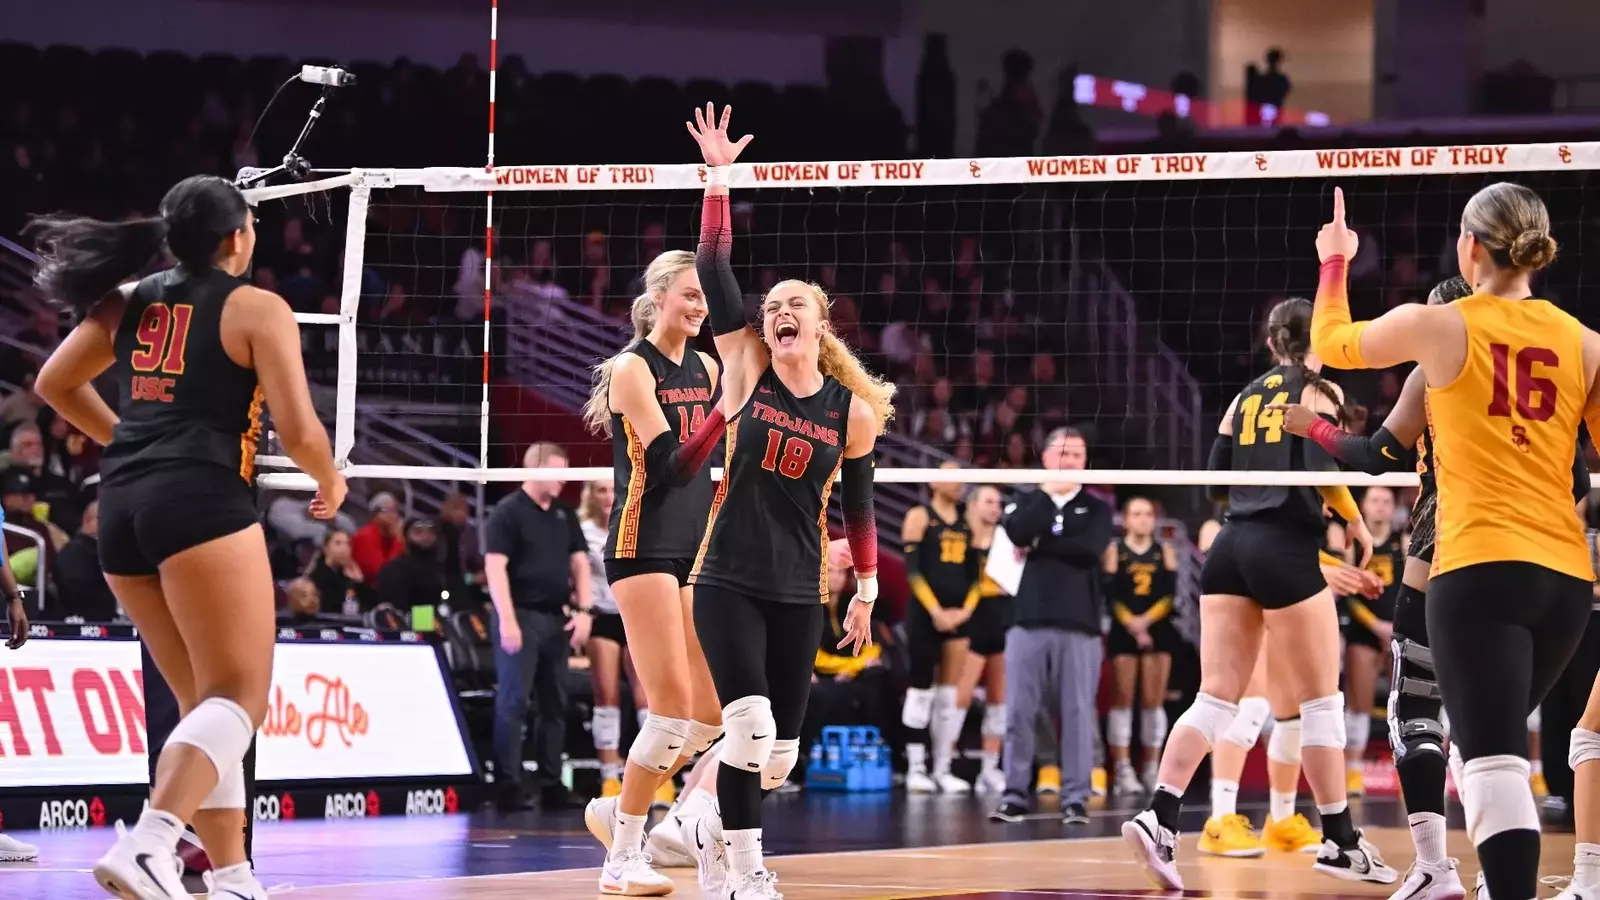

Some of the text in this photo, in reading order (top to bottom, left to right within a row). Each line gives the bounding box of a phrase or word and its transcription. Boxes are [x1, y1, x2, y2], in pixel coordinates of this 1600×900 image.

[1027, 155, 1207, 176] WOMEN OF TROY
[1316, 147, 1508, 168] WOMEN OF TROY
[495, 168, 568, 184] WOMEN
[576, 168, 600, 183] OF
[752, 162, 924, 181] WOMEN OF TROY
[131, 303, 194, 375] 91
[131, 375, 176, 402] USC
[658, 387, 710, 403] TROJANS
[1488, 342, 1559, 422] 16
[677, 404, 706, 443] 14
[751, 401, 839, 447] TROJANS
[1238, 391, 1289, 446] 14
[761, 428, 814, 479] 18
[305, 672, 369, 749] Ale
[39, 799, 89, 828] ARCO
[252, 795, 280, 820] CO
[325, 792, 366, 819] ARCO
[406, 789, 445, 815] ARCO
